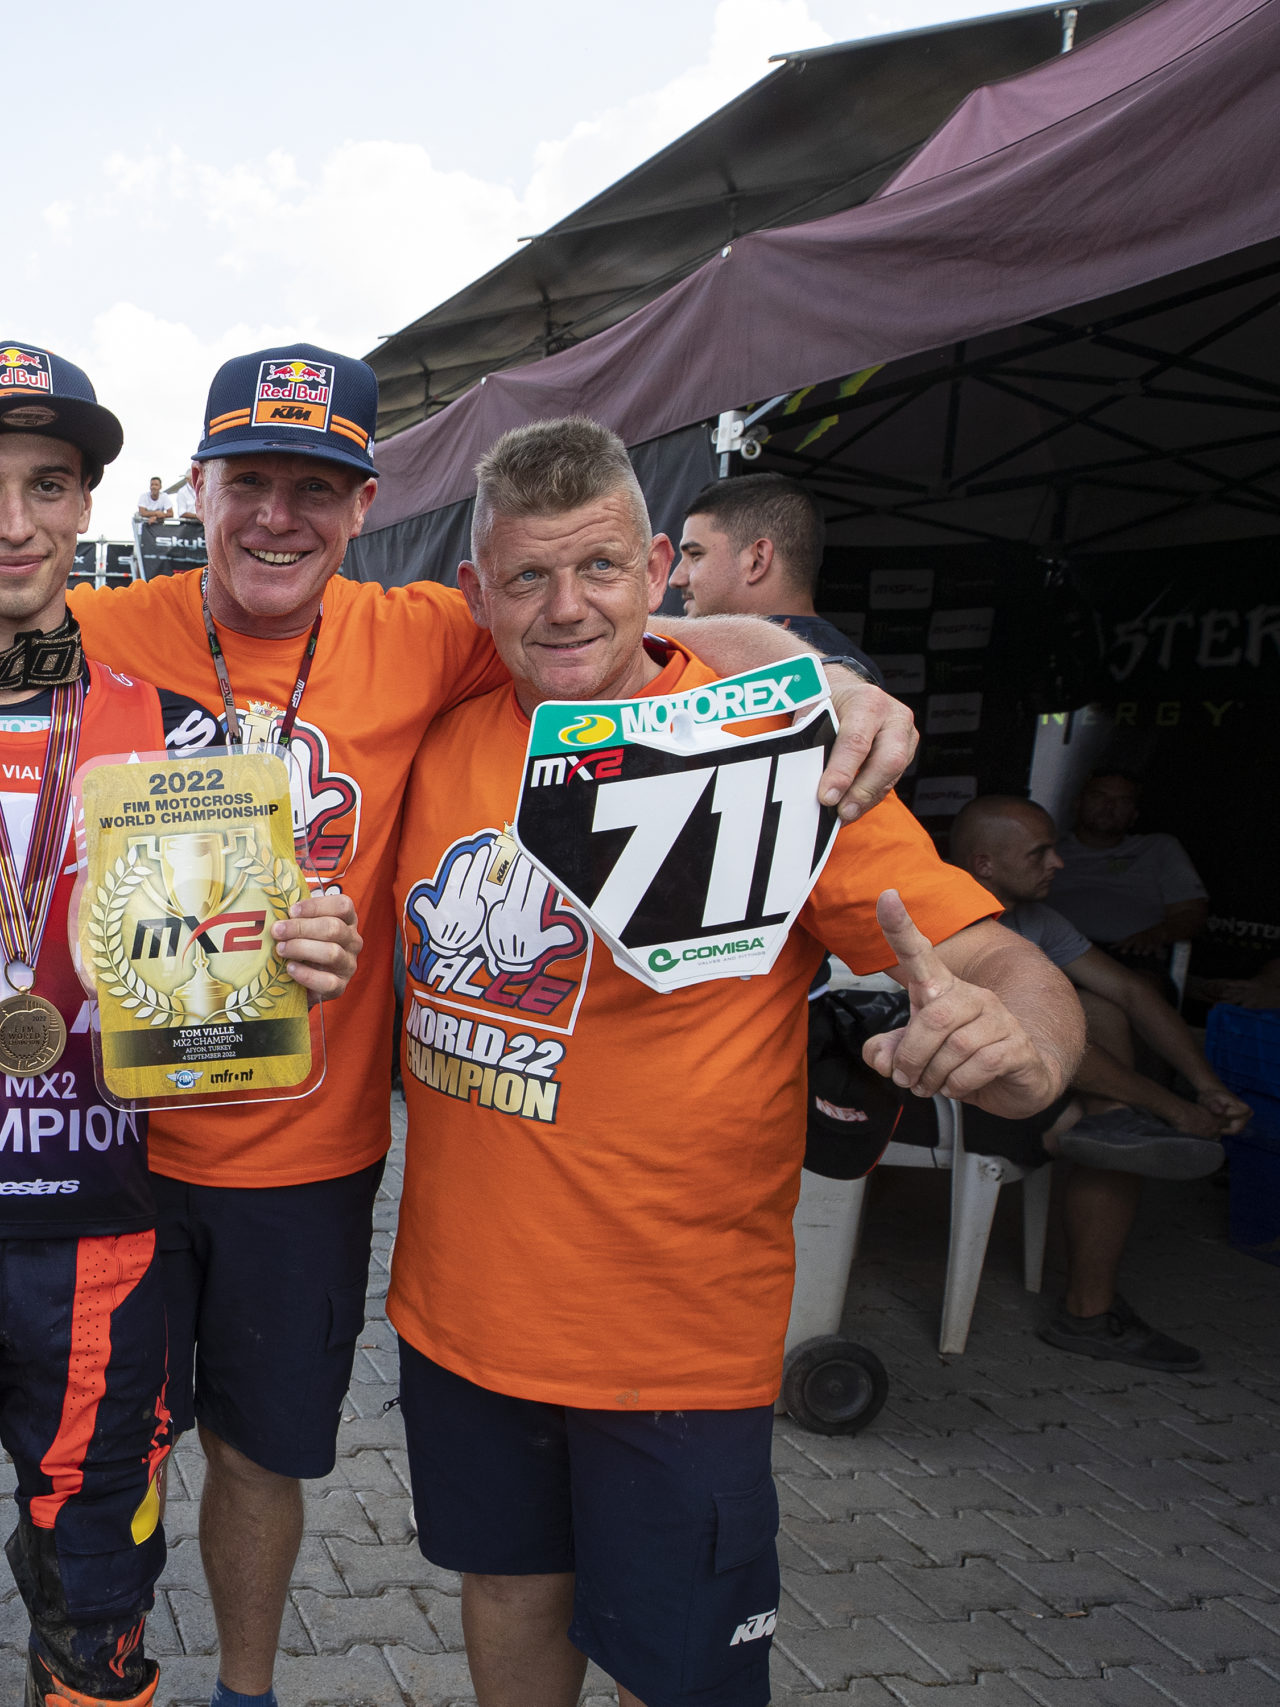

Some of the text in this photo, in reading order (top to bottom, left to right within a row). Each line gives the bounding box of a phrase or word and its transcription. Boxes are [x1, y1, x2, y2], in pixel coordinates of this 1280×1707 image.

[15, 368, 49, 389] Bull
[259, 382, 329, 403] Red Bull
[270, 405, 312, 421] KTM
[620, 675, 794, 734] MOTOREX
[530, 749, 624, 788] MX2
[149, 769, 225, 795] 2022
[123, 792, 254, 814] FIM MOTOCROSS
[99, 804, 279, 829] WORLD CHAMPIONSHIP
[589, 745, 825, 940] 711
[131, 910, 267, 968] MX2
[682, 937, 764, 961] COMISA
[173, 1034, 243, 1047] MX2 CHAMPION
[179, 1026, 235, 1038] TOM VIALLE
[187, 1052, 222, 1061] SEPTEMBER
[6, 1072, 77, 1099] MX2
[406, 1035, 560, 1123] CHAMPION
